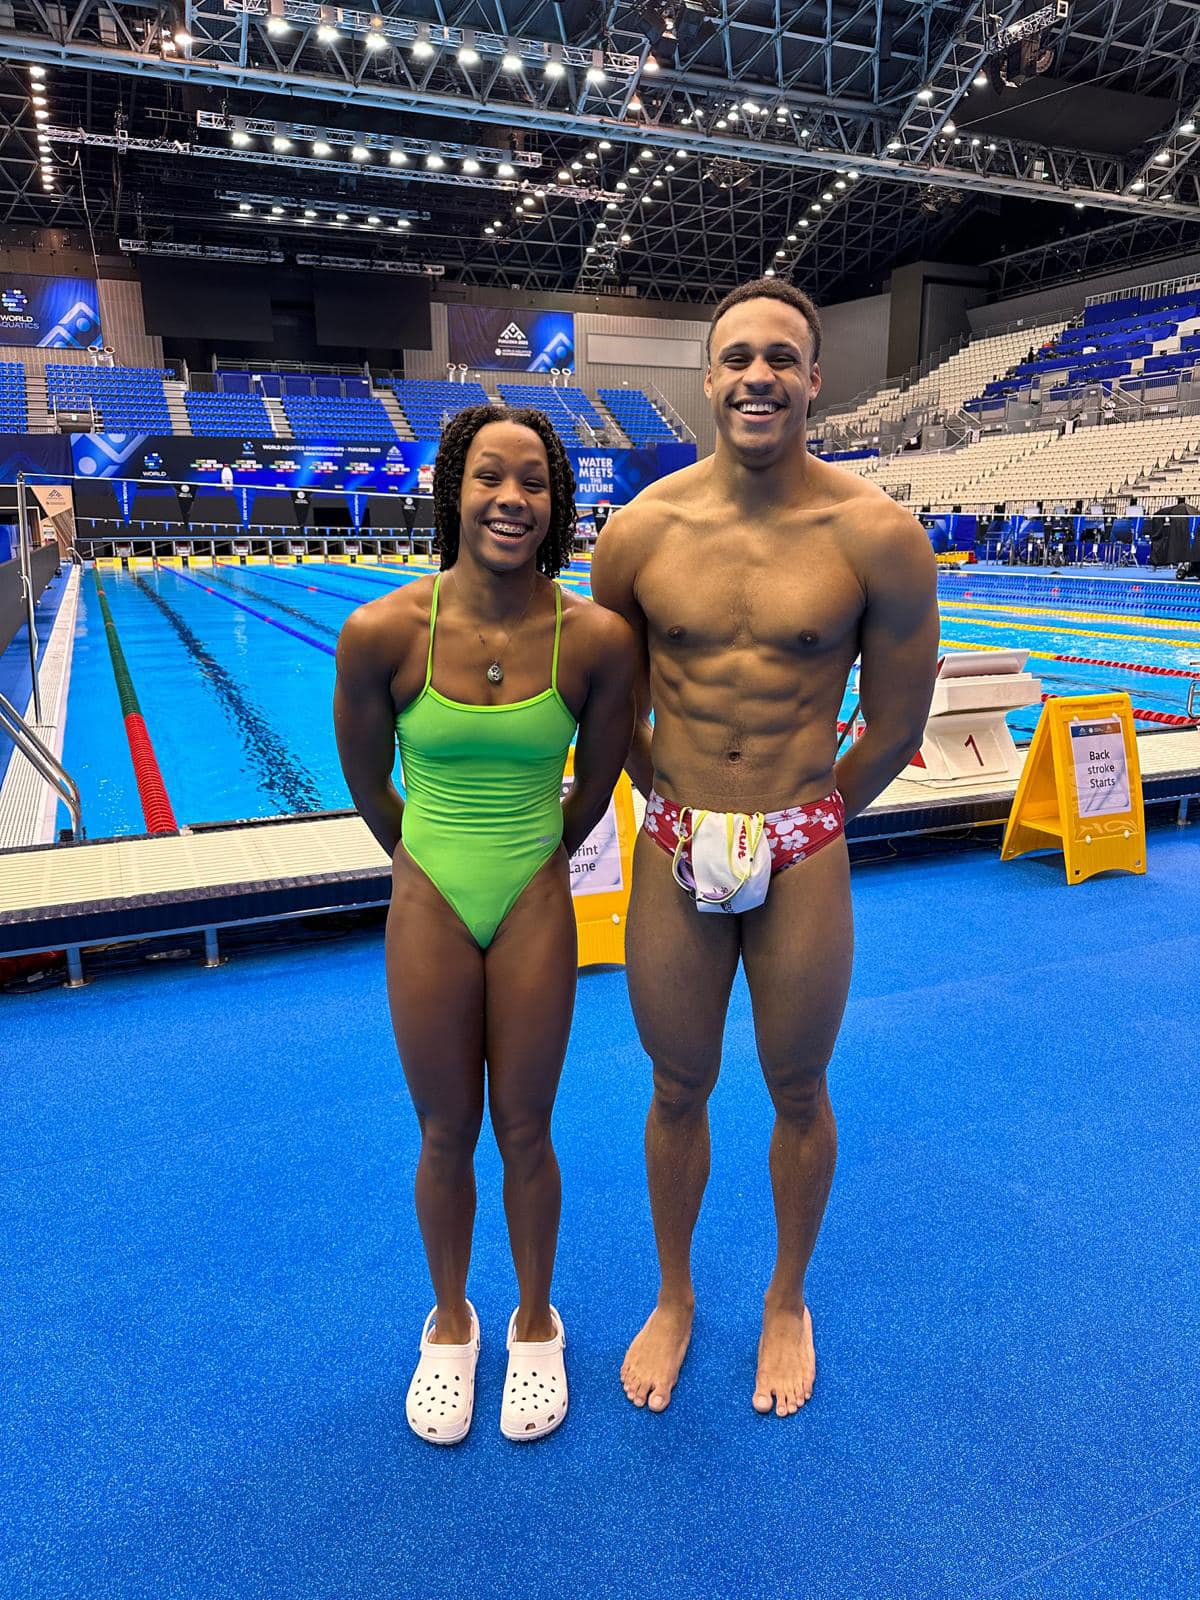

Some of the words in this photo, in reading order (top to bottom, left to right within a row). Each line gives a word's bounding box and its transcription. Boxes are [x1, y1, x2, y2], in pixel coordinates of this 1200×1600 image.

[0, 321, 40, 329] QUATICS
[578, 457, 613, 468] WATER
[579, 467, 613, 478] MEETS
[579, 483, 613, 493] FUTURE
[964, 734, 984, 767] 1
[1089, 749, 1110, 761] Back
[1087, 763, 1115, 775] stroke
[1090, 777, 1115, 789] Starts
